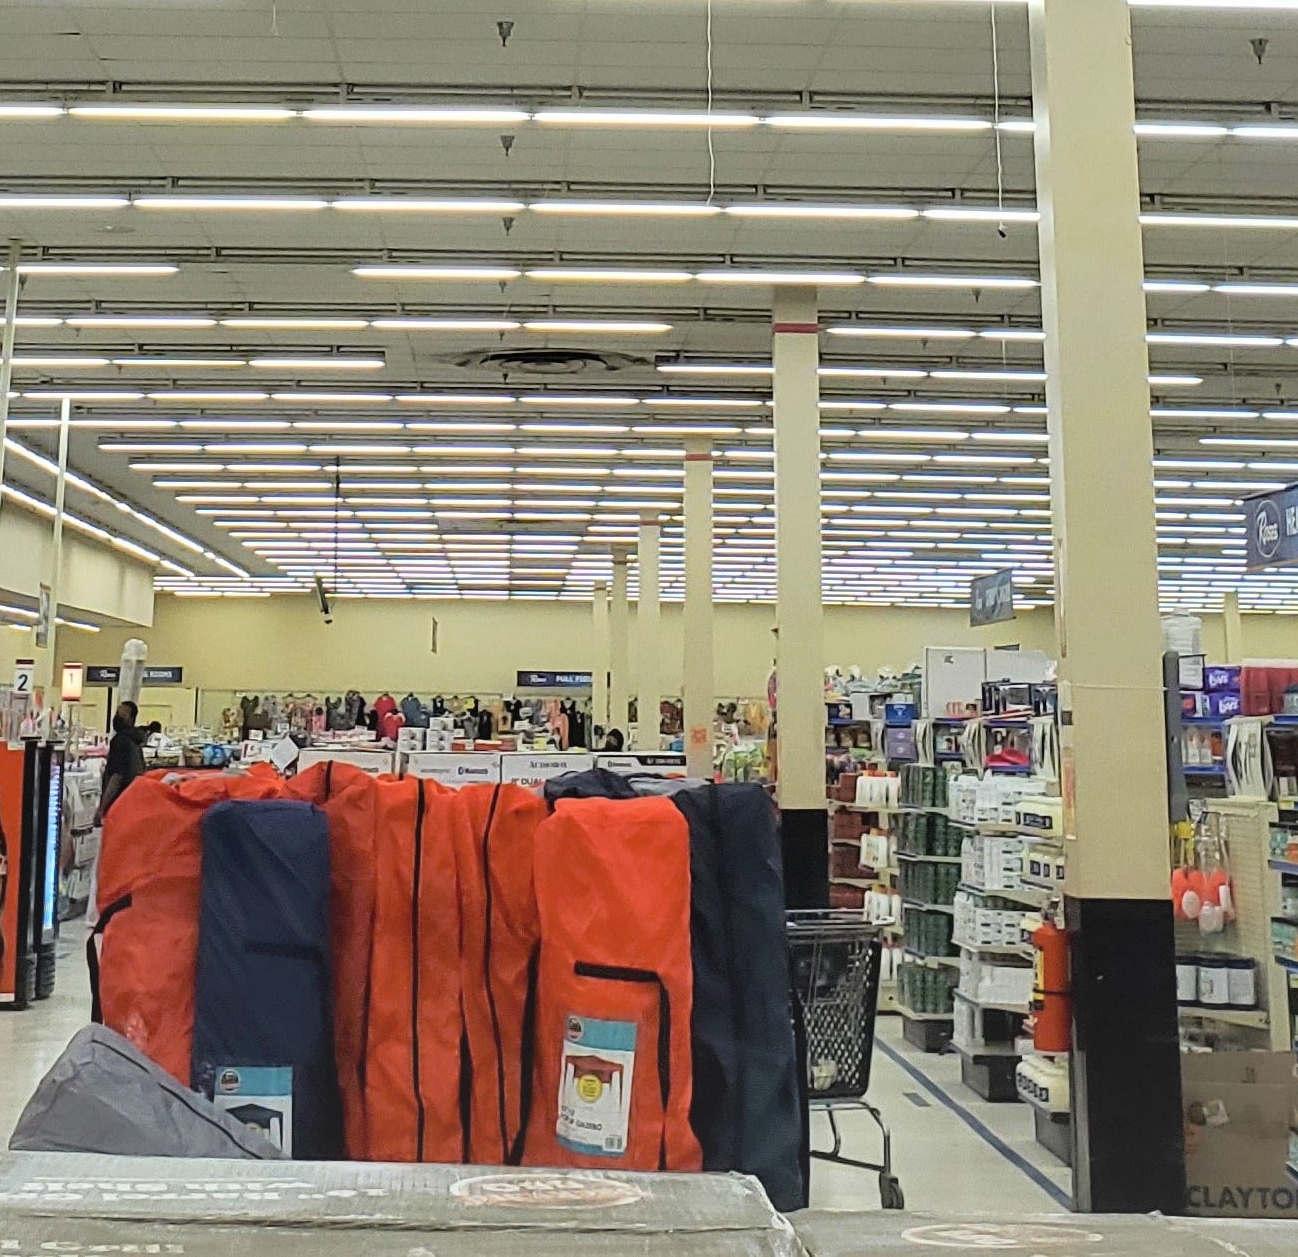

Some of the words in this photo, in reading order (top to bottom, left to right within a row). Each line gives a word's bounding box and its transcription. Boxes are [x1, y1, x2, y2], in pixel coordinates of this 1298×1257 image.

[22, 1182, 169, 1191] Shelf
[185, 1182, 315, 1191] with
[102, 1192, 280, 1201] Barrel
[40, 1241, 185, 1254] Grill
